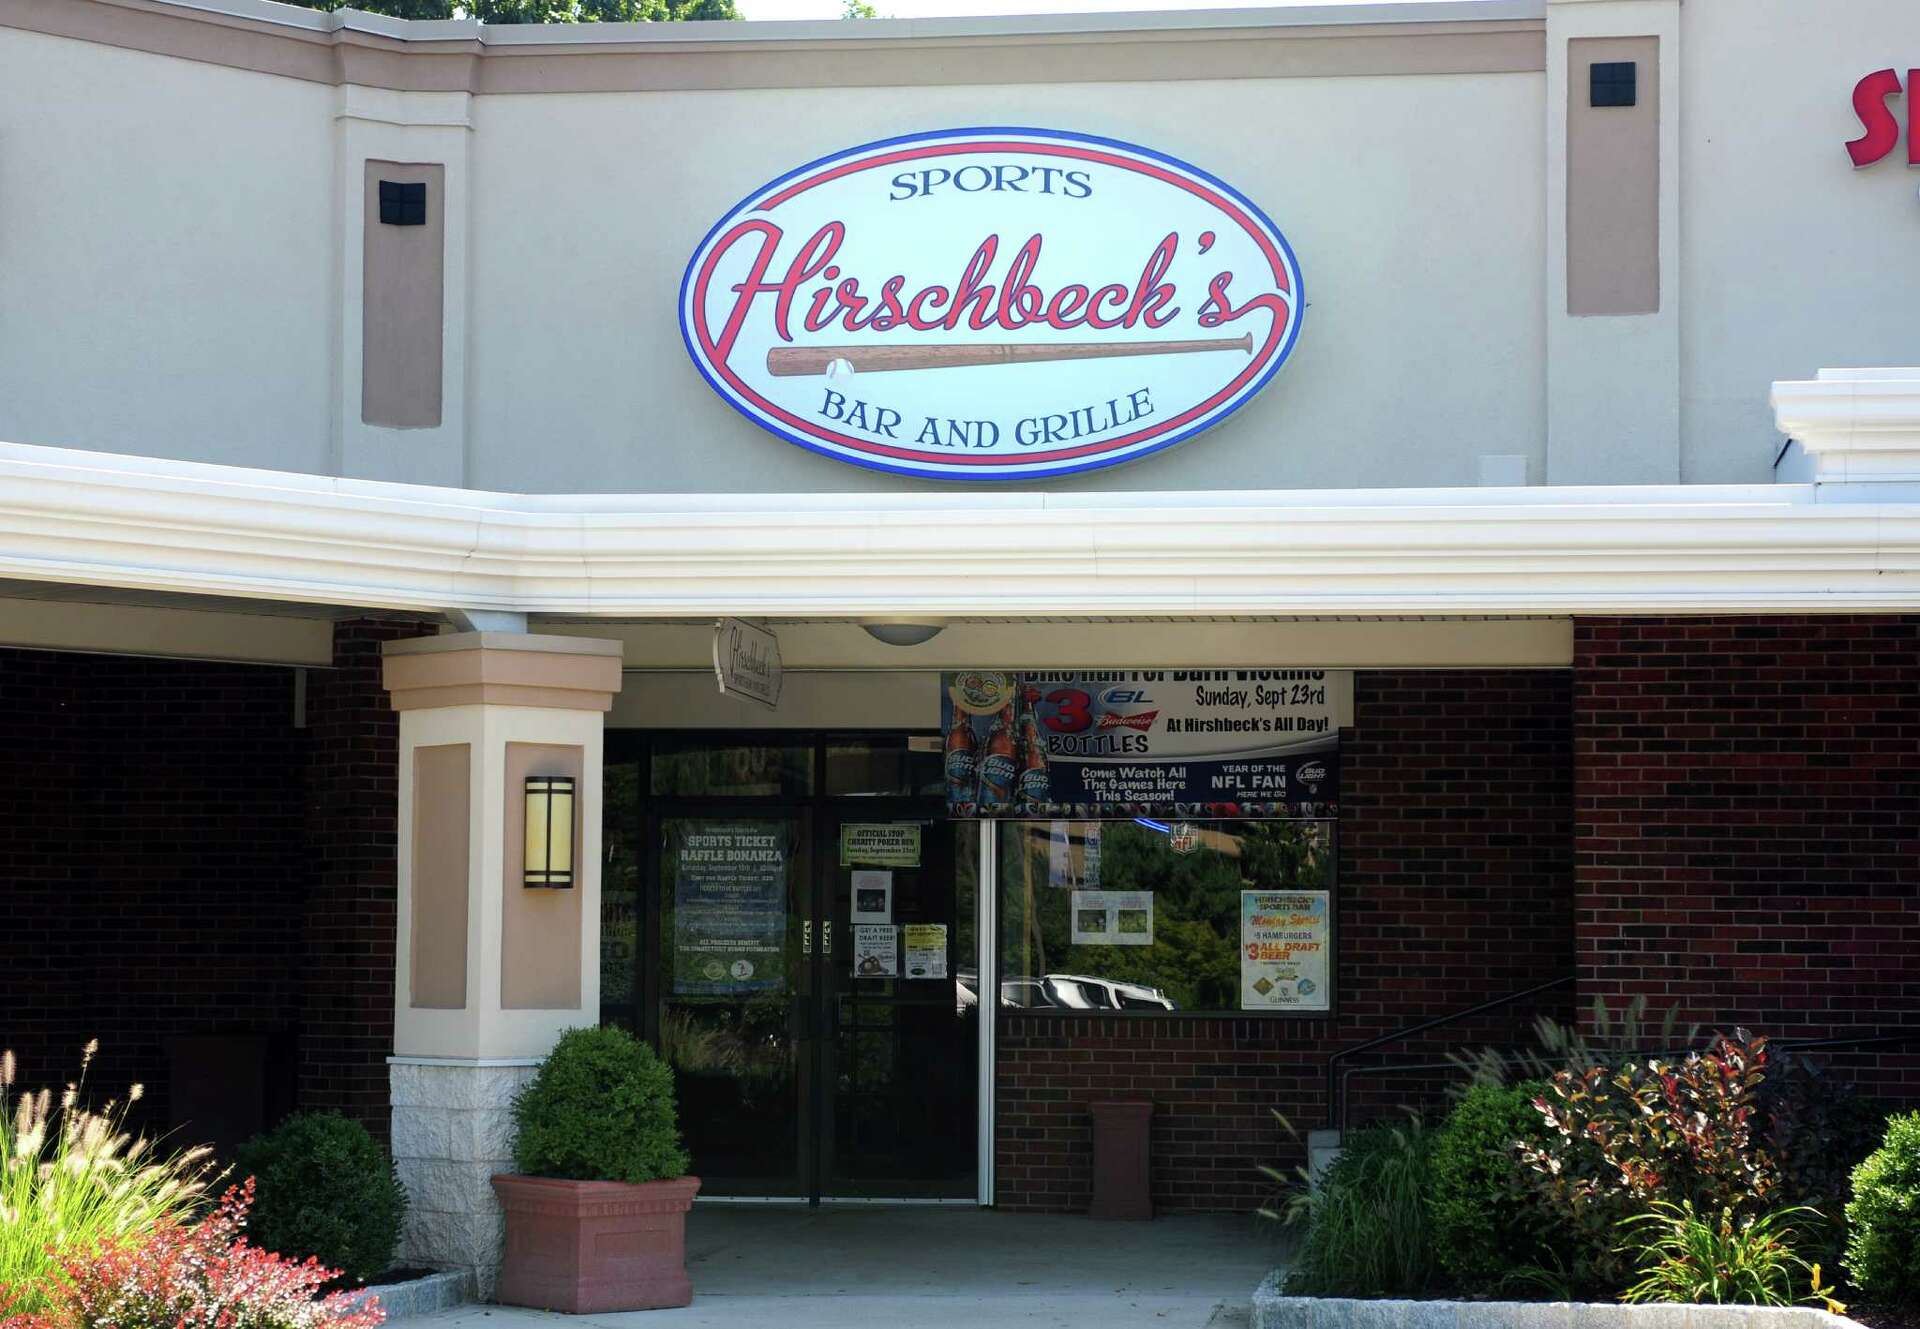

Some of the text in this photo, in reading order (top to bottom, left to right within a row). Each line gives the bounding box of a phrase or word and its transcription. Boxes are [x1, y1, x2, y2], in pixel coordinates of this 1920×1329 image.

[1845, 68, 1920, 167] S
[889, 164, 1093, 201] SPORTS
[695, 219, 1268, 364] Hirschbeck's
[819, 386, 1156, 449] BAR AND GRILLE
[1196, 684, 1325, 709] Sunday, Sept 23rd
[1166, 717, 1329, 733] At Hirshbeck's All Day!
[1048, 735, 1149, 753] BOTTLES
[1081, 766, 1186, 778] Come Watch All
[1222, 764, 1287, 773] YEAR OF THE
[1082, 778, 1187, 790] The Games Here
[1211, 775, 1287, 789] NFL FAN
[1094, 790, 1175, 801] This Season!
[1236, 790, 1287, 798] HERE WE GO
[687, 835, 776, 847] SPORTS TICKET
[681, 849, 783, 861] RAFFLE BONANZA
[1262, 931, 1313, 940] HAMBURGERS
